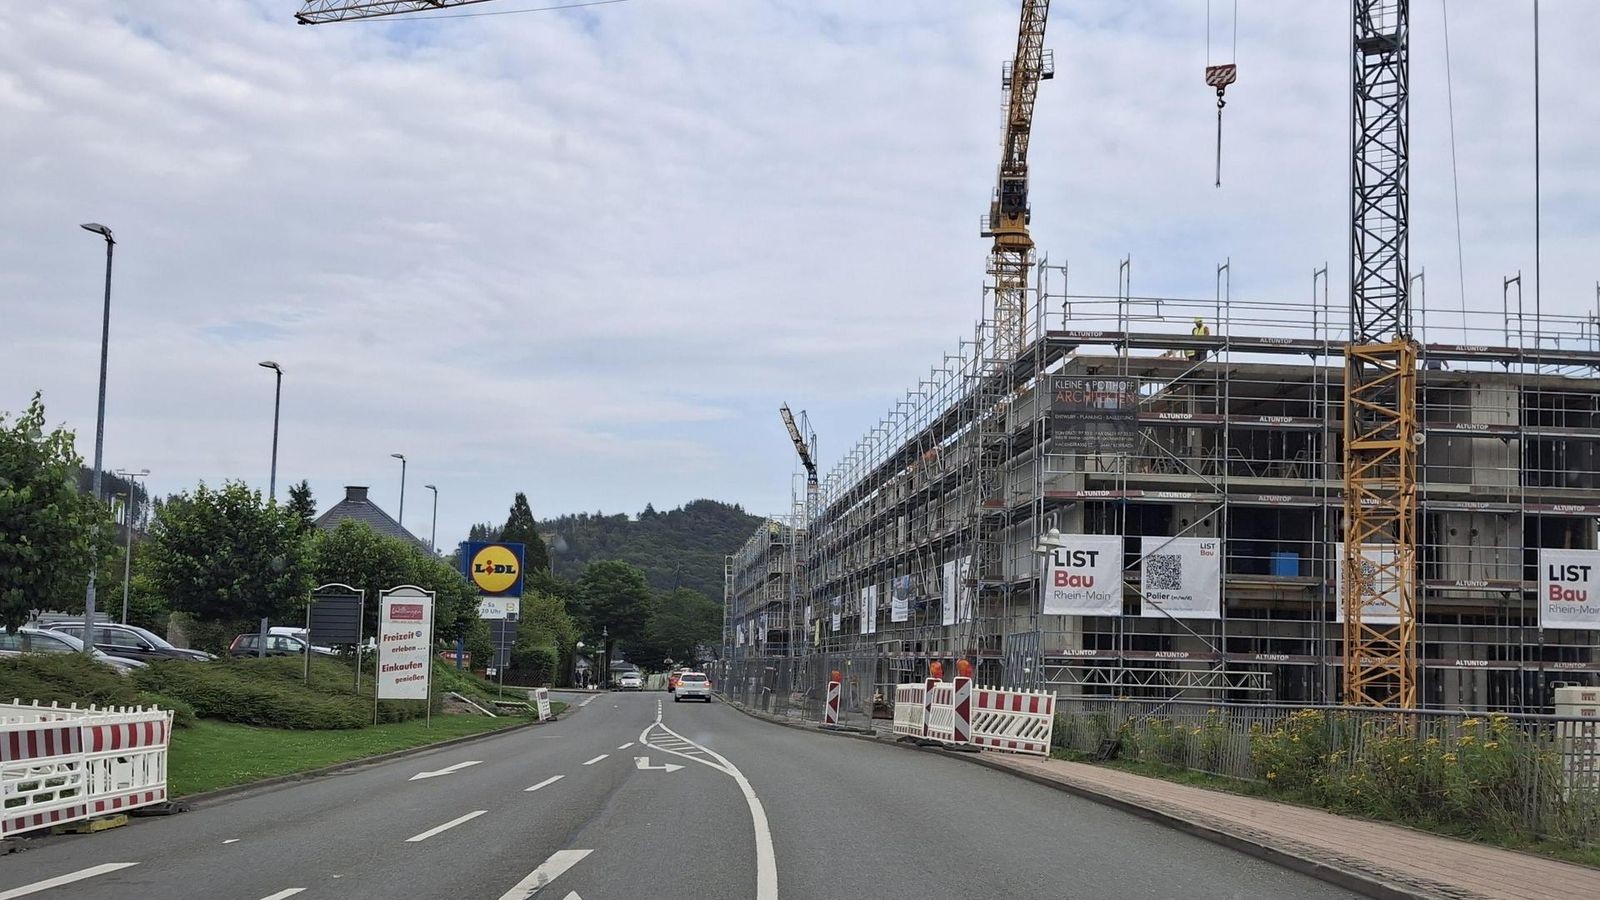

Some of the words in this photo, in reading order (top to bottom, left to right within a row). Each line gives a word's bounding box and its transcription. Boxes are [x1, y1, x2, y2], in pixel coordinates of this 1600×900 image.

[1055, 380, 1083, 390] KLEINE
[1092, 380, 1135, 391] POTTHOFF
[1055, 390, 1136, 405] ARCHITEKTEN
[1054, 549, 1099, 568] LIST
[475, 560, 516, 576] LIDL
[1549, 564, 1591, 582] LIST
[1054, 570, 1094, 588] Bau
[1054, 590, 1111, 601] Rhein-Main
[1146, 592, 1170, 600] Polier
[1549, 584, 1587, 602] Bau
[383, 631, 415, 642] Freizeit
[381, 661, 423, 673] Einkaufen
[394, 673, 425, 684] genießen
